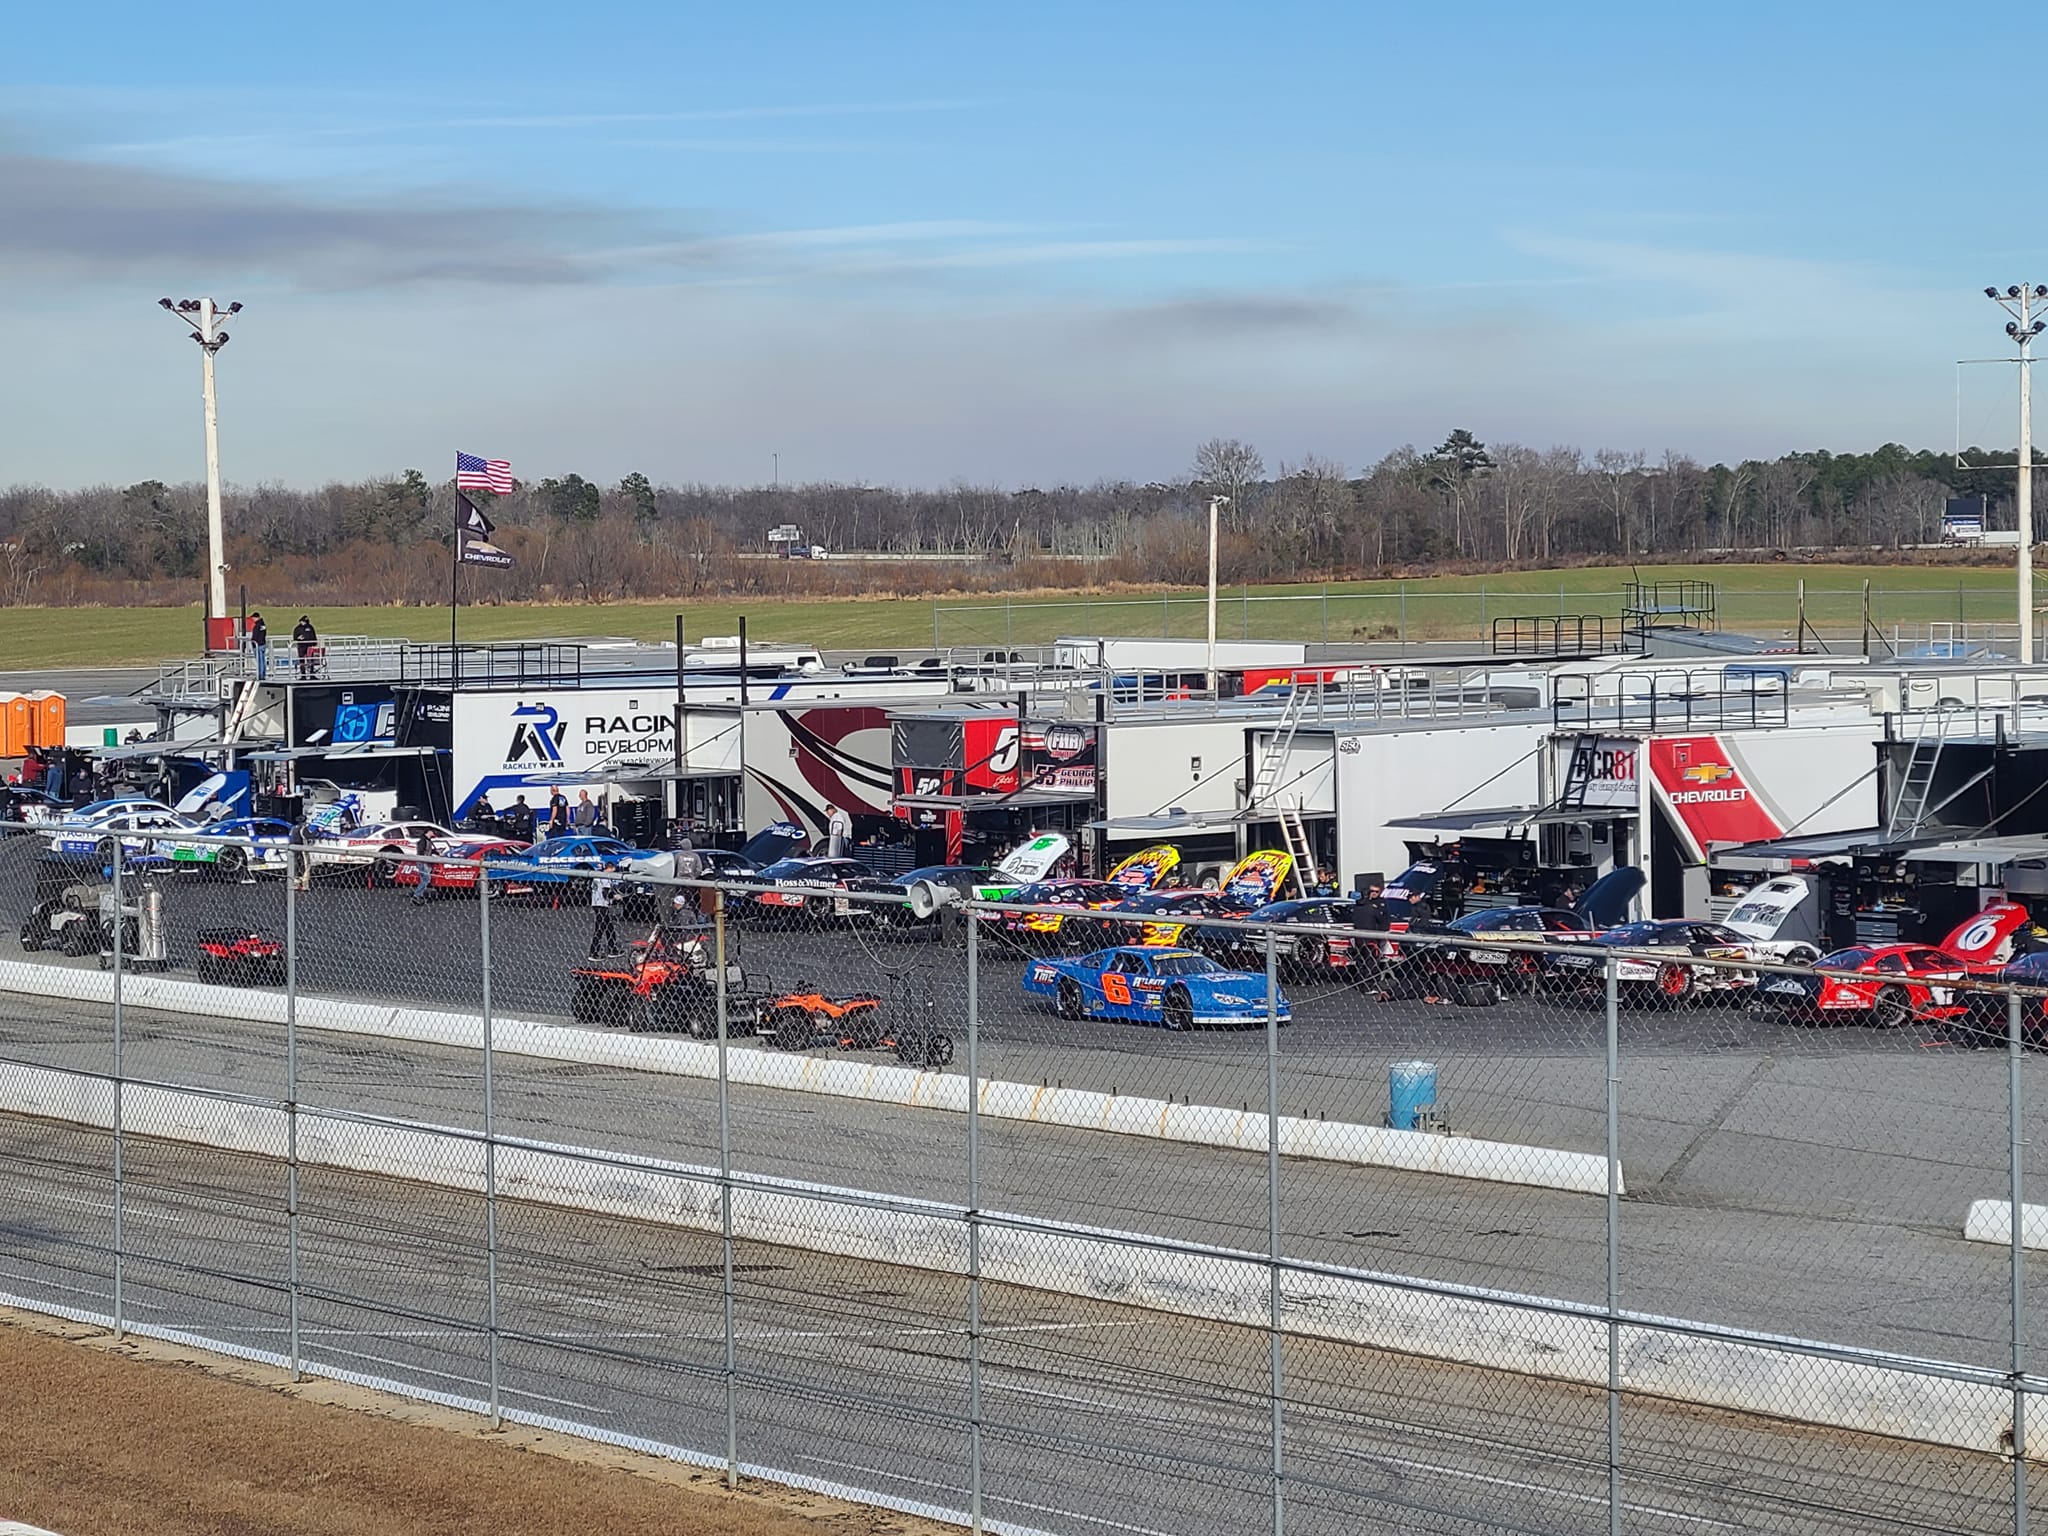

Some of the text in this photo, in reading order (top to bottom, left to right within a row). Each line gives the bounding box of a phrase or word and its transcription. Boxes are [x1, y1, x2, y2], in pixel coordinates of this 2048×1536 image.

[464, 553, 512, 564] CHEVROLET
[585, 715, 675, 734] RACIN
[585, 739, 673, 754] DEVELOPM
[502, 761, 565, 770] RACKLEY WAR
[606, 756, 674, 765] www.rackleywar.c
[1035, 764, 1056, 786] 55
[1059, 778, 1095, 786] PHILLIP
[1617, 780, 1638, 793] Racin
[1670, 789, 1748, 804] CHEVROLET
[775, 878, 836, 888] Ross&Witmer
[1957, 918, 2001, 951] 6
[1101, 972, 1132, 1006] 6
